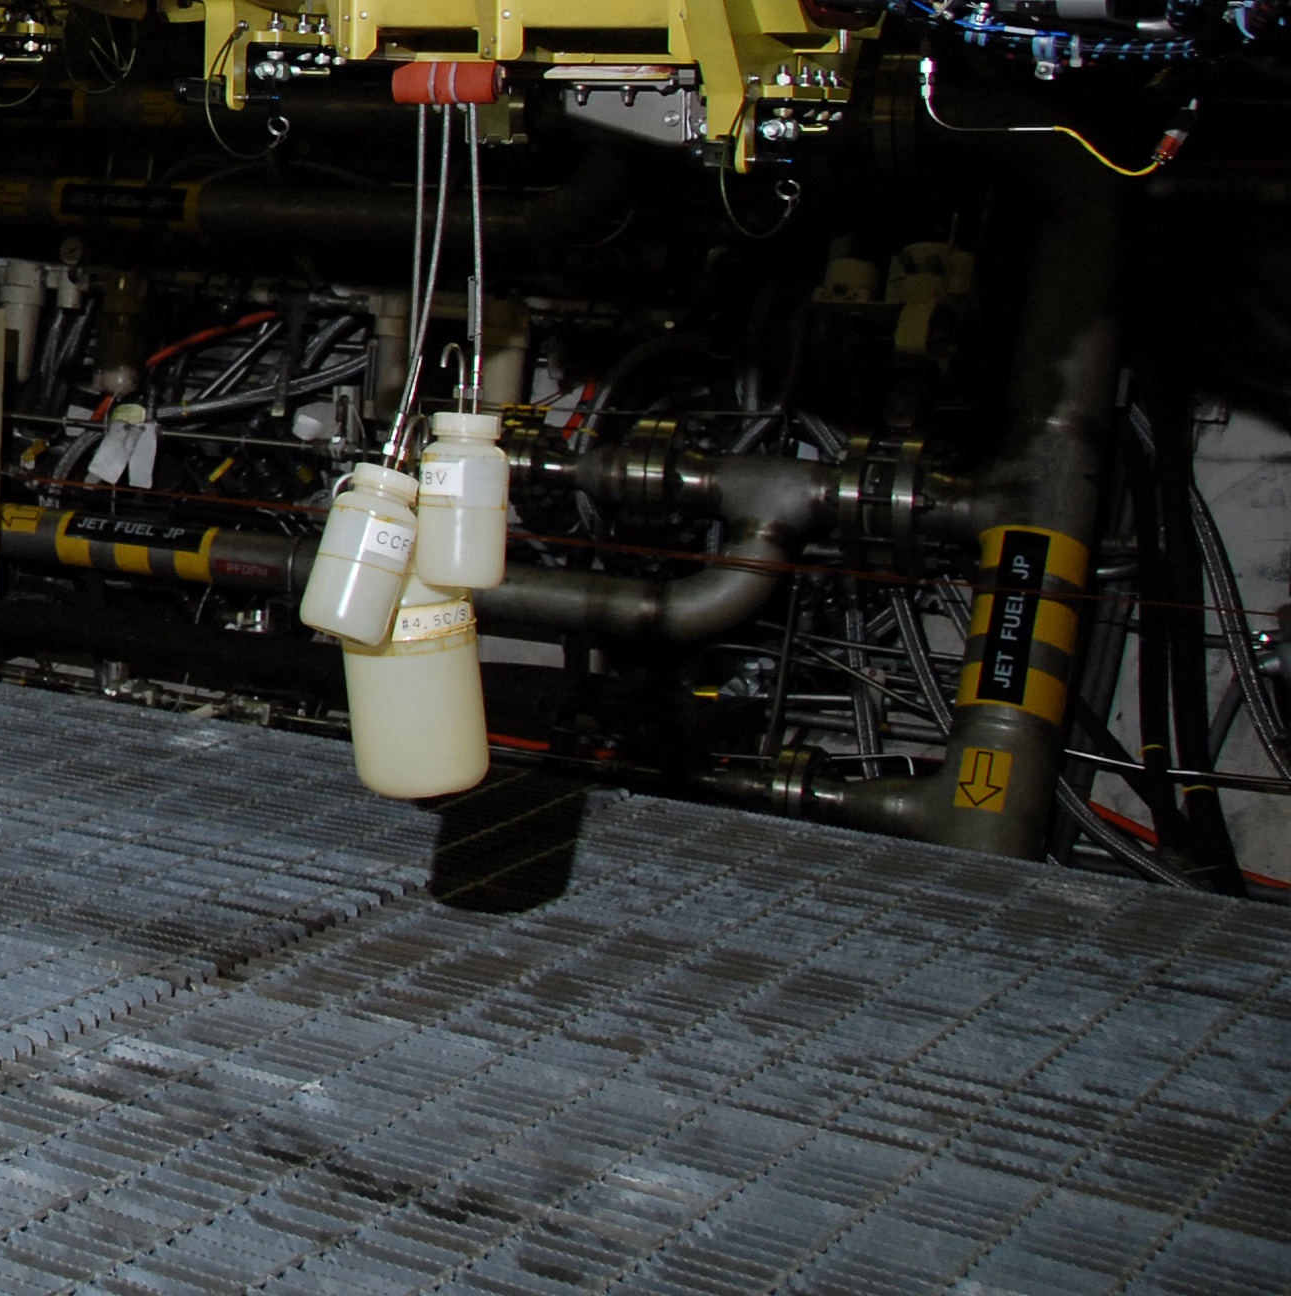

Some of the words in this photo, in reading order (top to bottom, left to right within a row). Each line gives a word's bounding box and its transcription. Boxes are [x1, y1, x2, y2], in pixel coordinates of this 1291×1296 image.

[76, 517, 107, 531] JET
[114, 521, 155, 536] FUEL
[162, 525, 186, 540] JP
[1011, 554, 1031, 581] JP
[1000, 590, 1026, 642] FUEL
[992, 649, 1016, 689] JET
